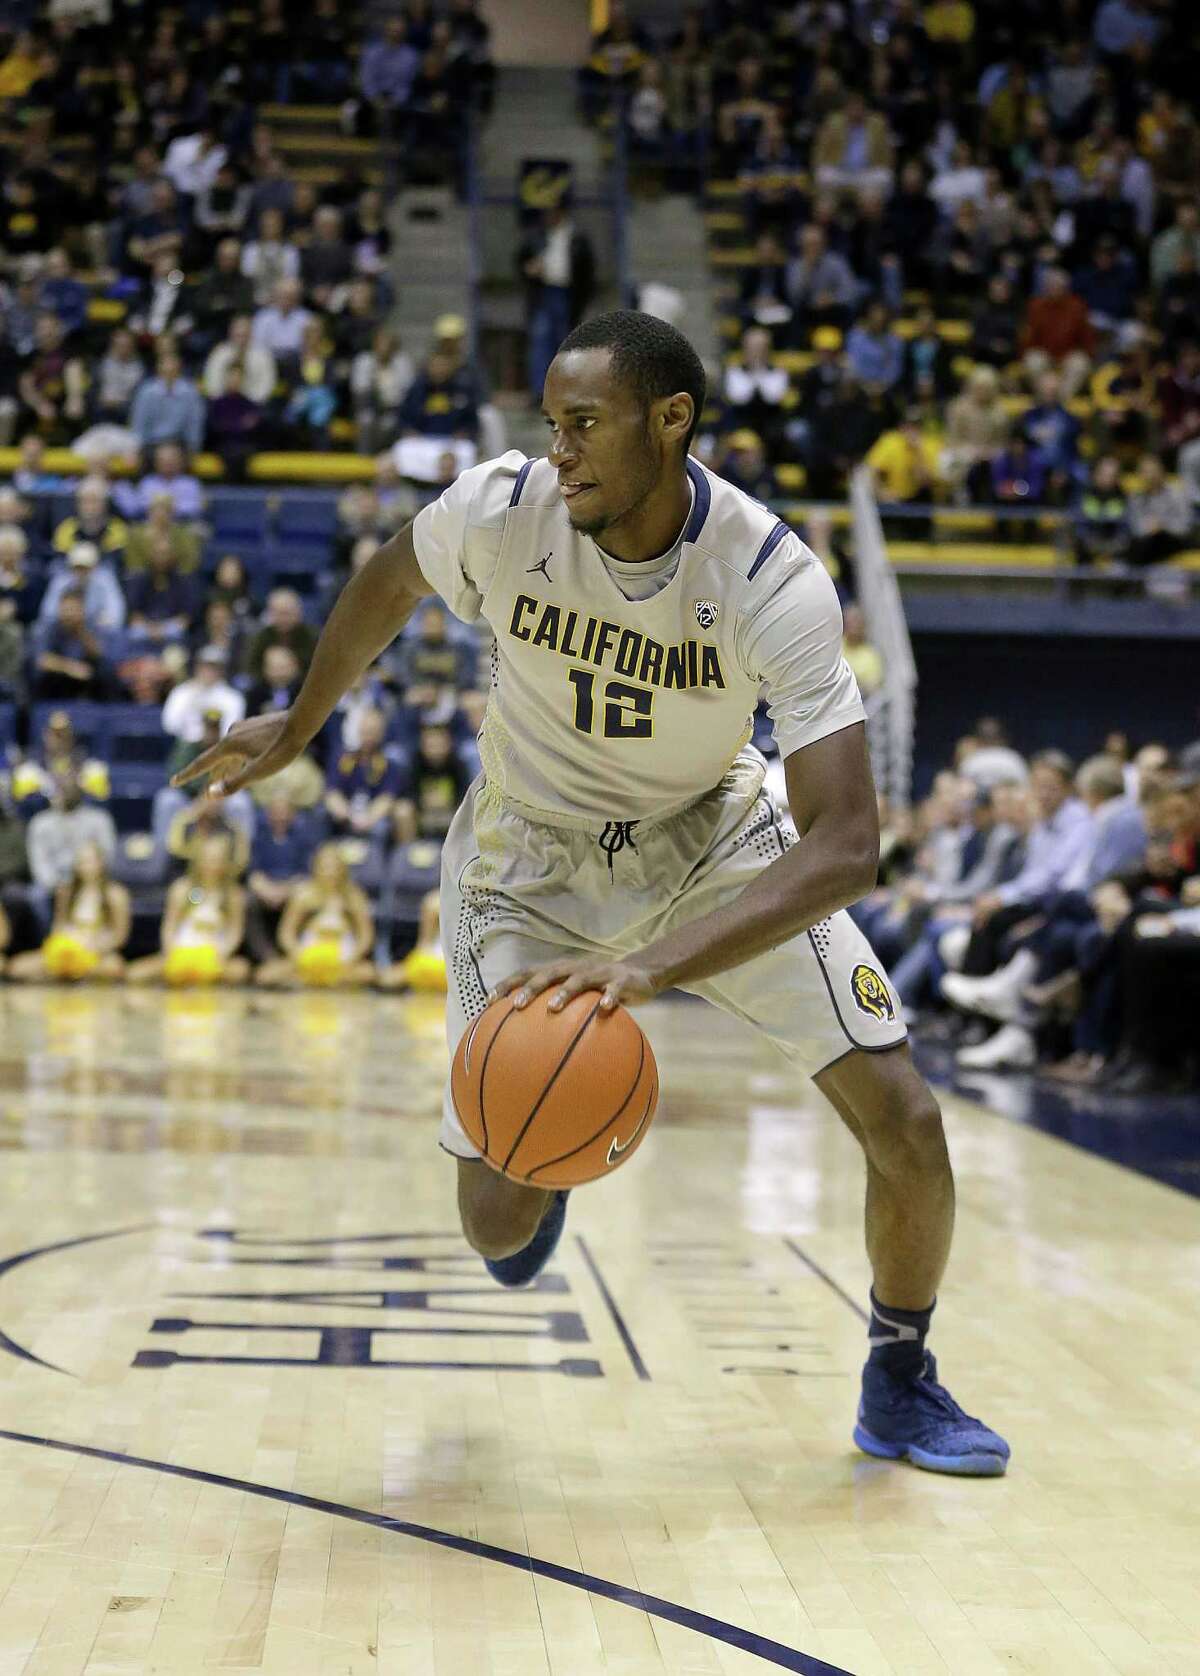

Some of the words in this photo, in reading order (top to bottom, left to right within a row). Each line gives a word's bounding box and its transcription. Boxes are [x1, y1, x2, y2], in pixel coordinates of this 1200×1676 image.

[508, 593, 727, 690] CALIFORNIA
[699, 613, 711, 625] 12
[568, 667, 654, 739] 12
